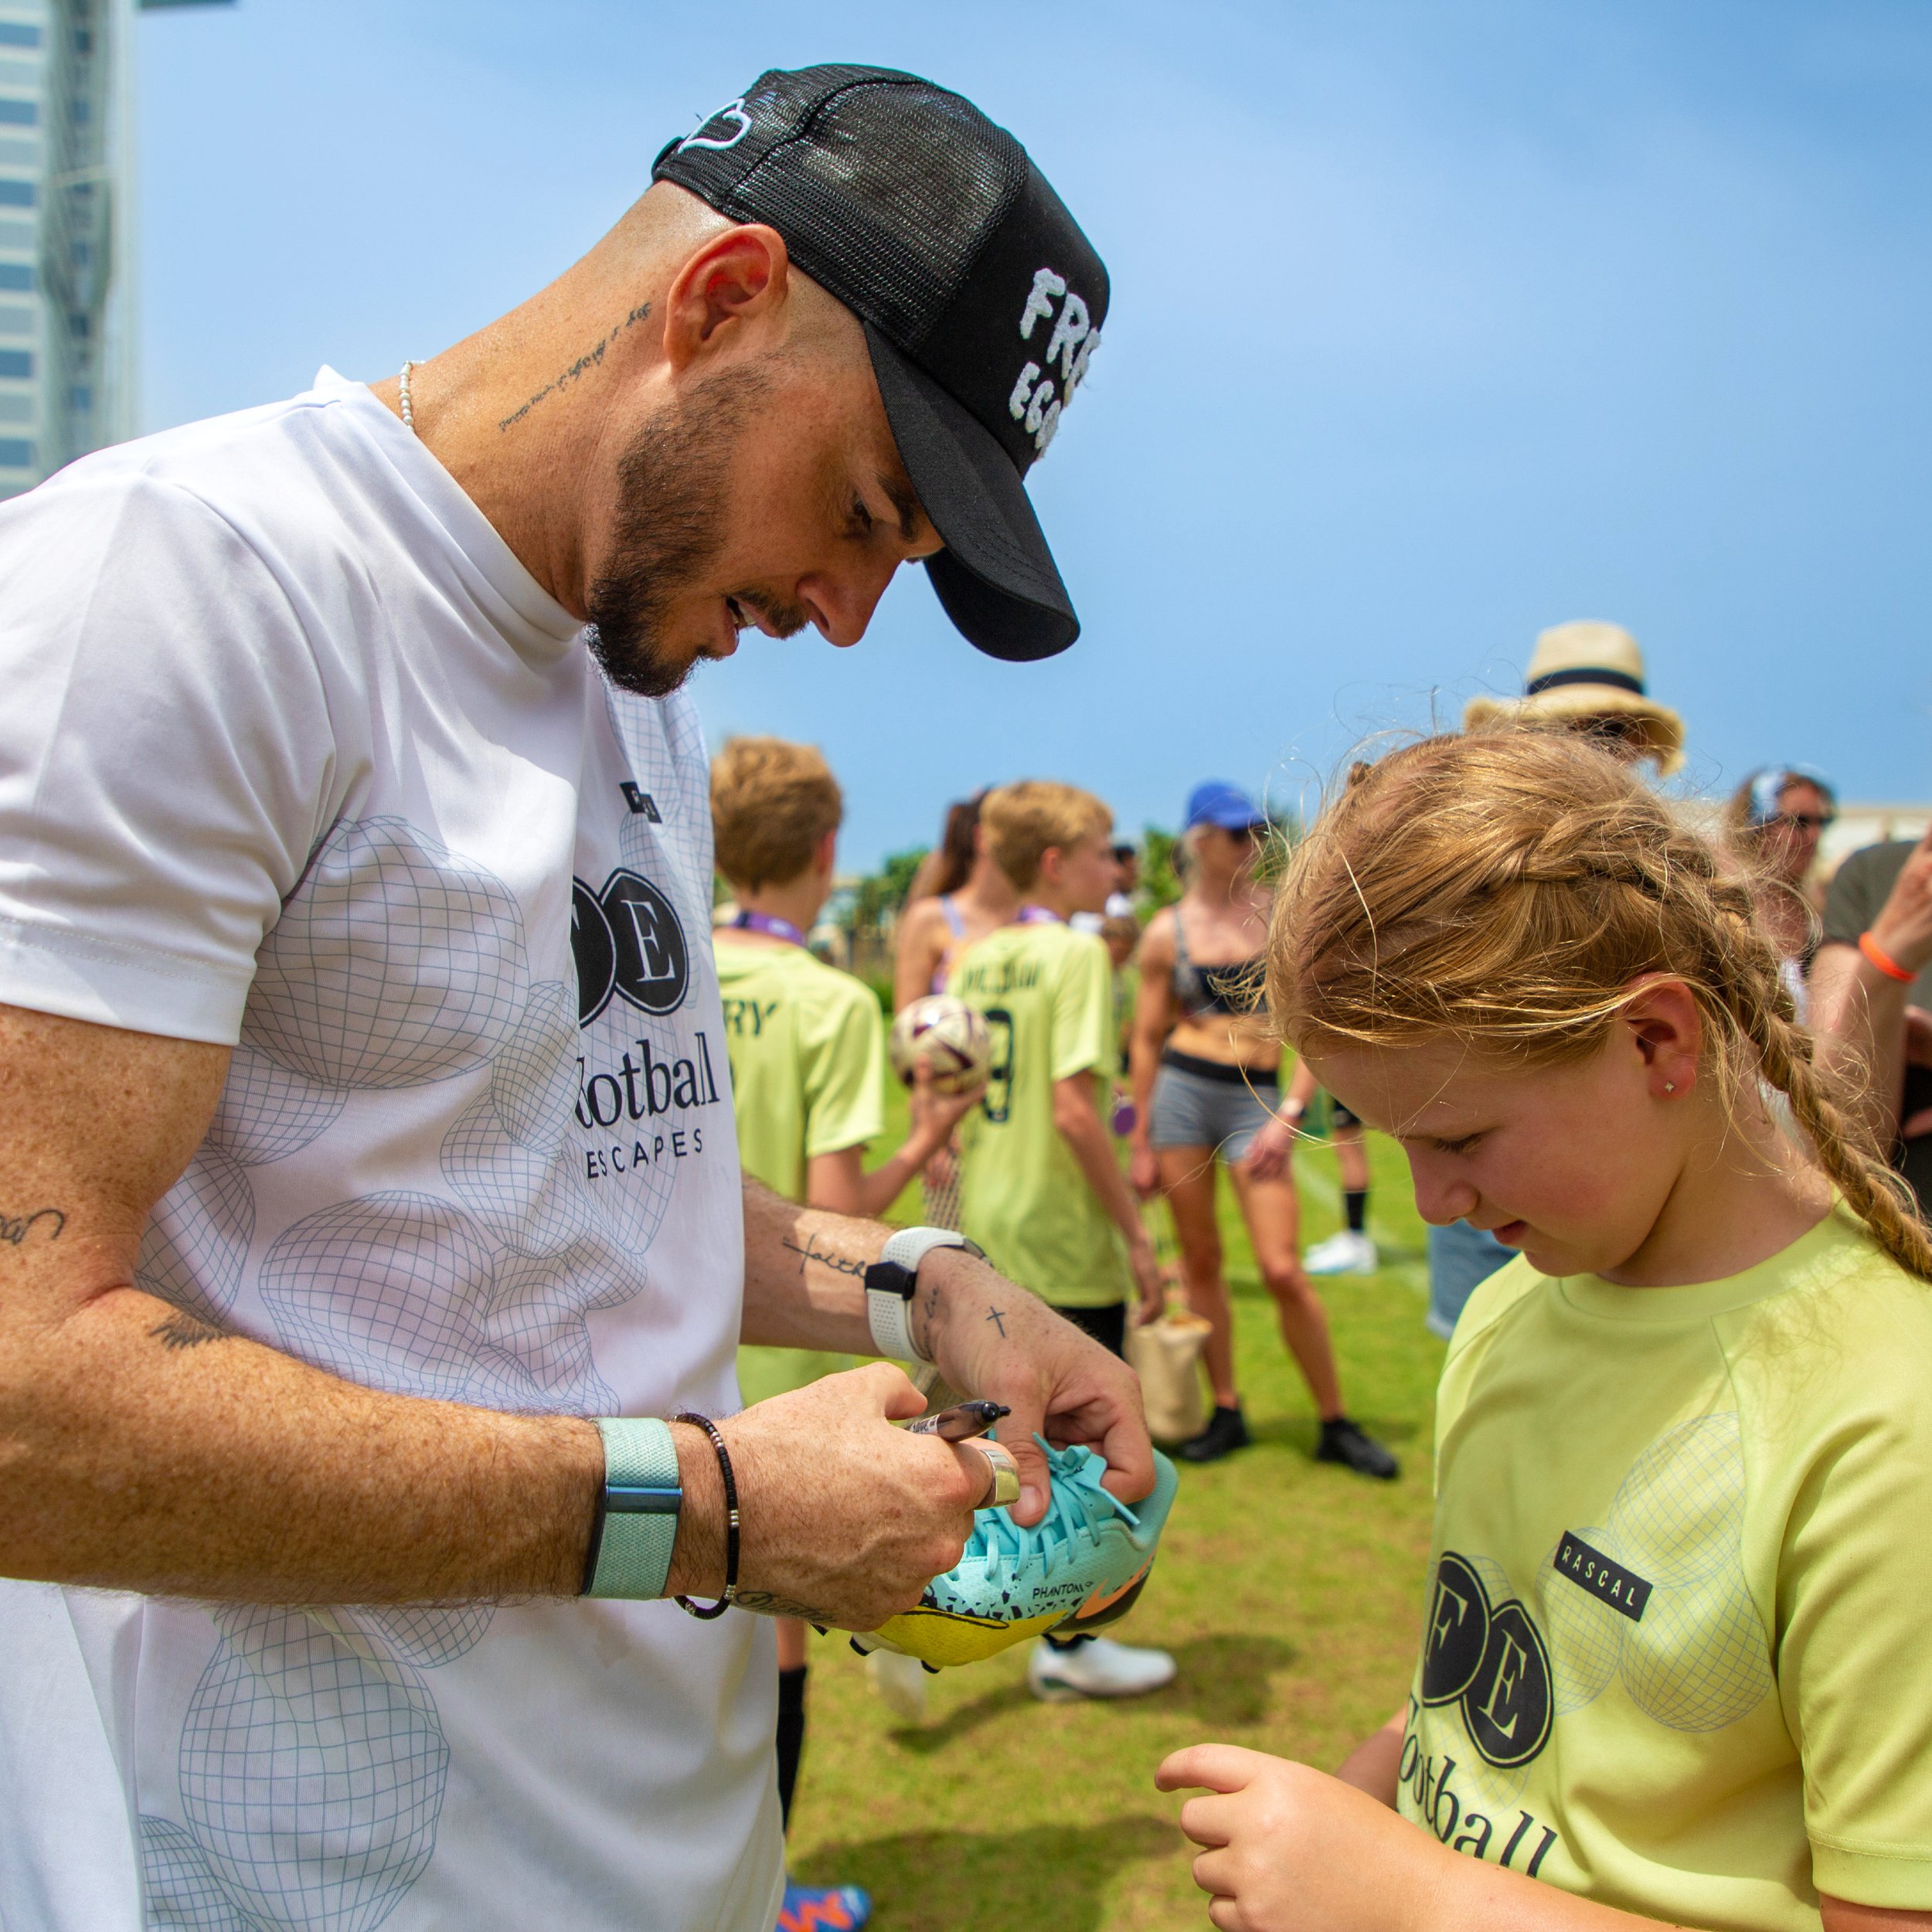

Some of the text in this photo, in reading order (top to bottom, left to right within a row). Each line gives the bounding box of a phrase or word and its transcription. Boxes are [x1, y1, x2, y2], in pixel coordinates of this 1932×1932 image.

[621, 899, 676, 983] E
[586, 1128, 703, 1179] ESCAPES
[1561, 1545, 1635, 1607] RASCAL
[1476, 1627, 1528, 1740] E
